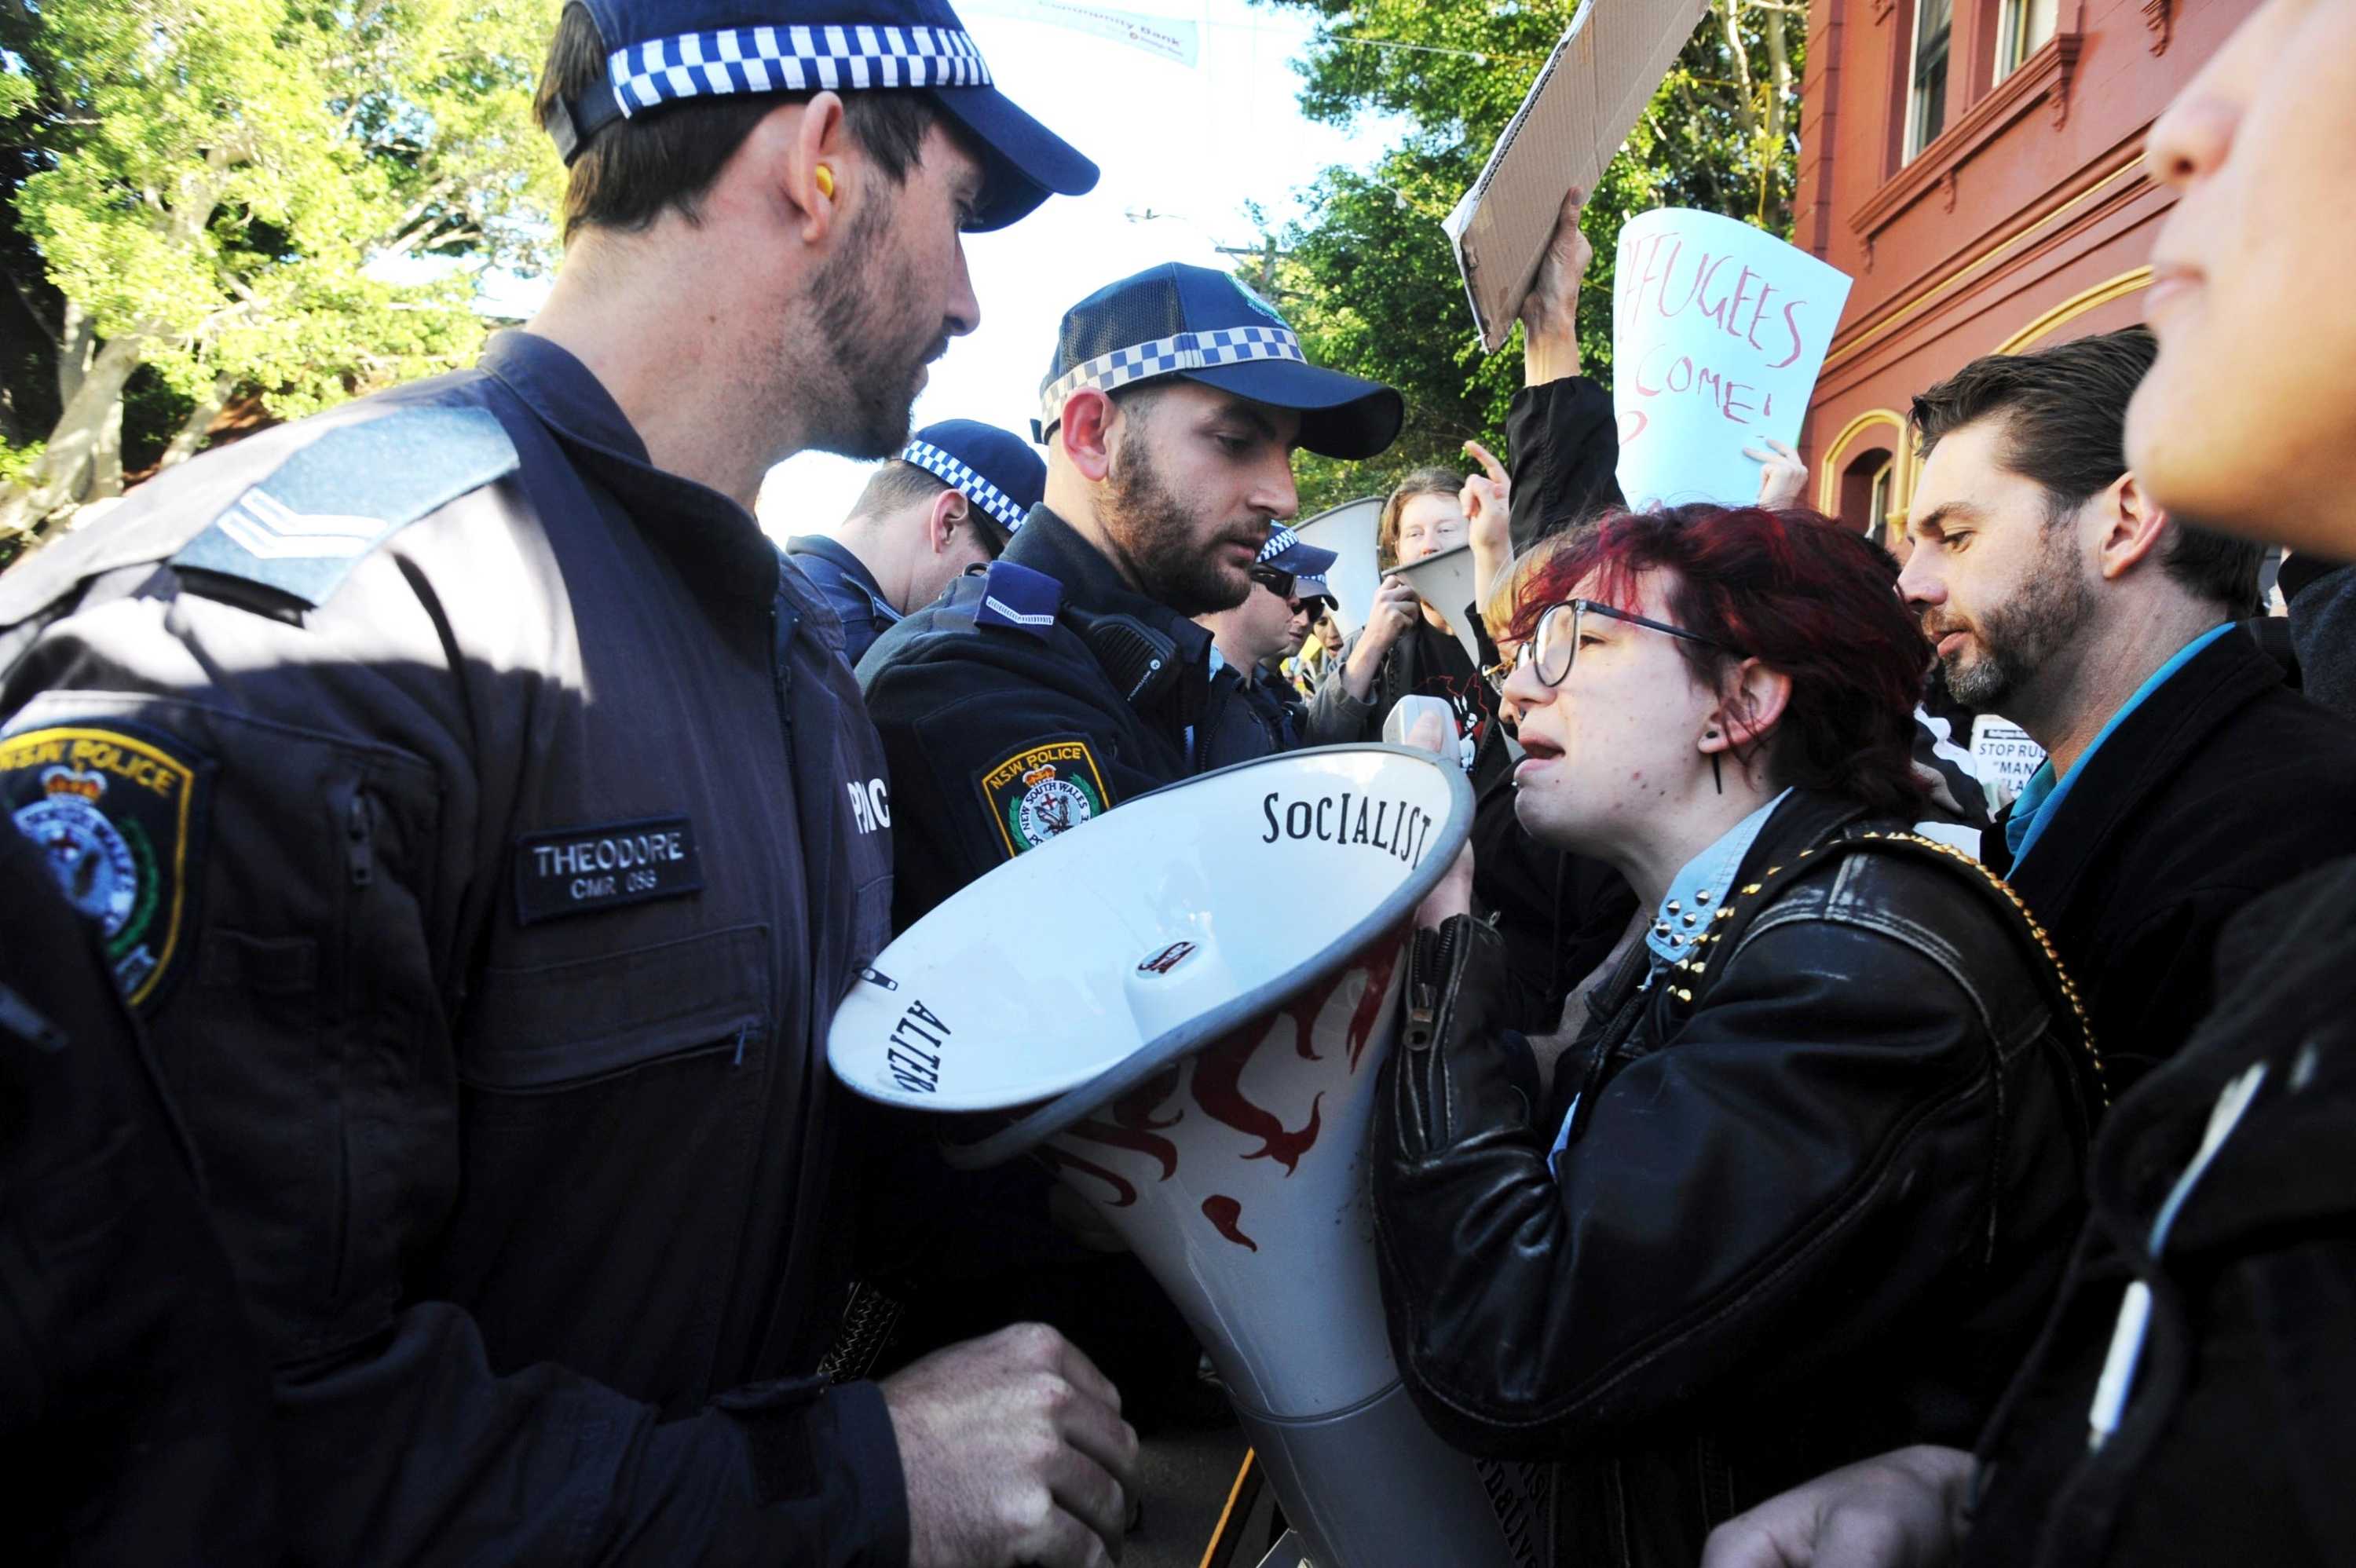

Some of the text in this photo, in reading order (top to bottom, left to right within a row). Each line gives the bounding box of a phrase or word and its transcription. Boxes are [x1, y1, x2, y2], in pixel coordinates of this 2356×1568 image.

[71, 739, 177, 798] POLICE
[1026, 747, 1081, 767] POLICE
[1979, 743, 2015, 756] STOP
[1021, 782, 1088, 831] NEW SOUTH WALES
[1262, 791, 1432, 871] SOCIALIST
[532, 832, 685, 877] THEODORE
[569, 876, 617, 901] CMR
